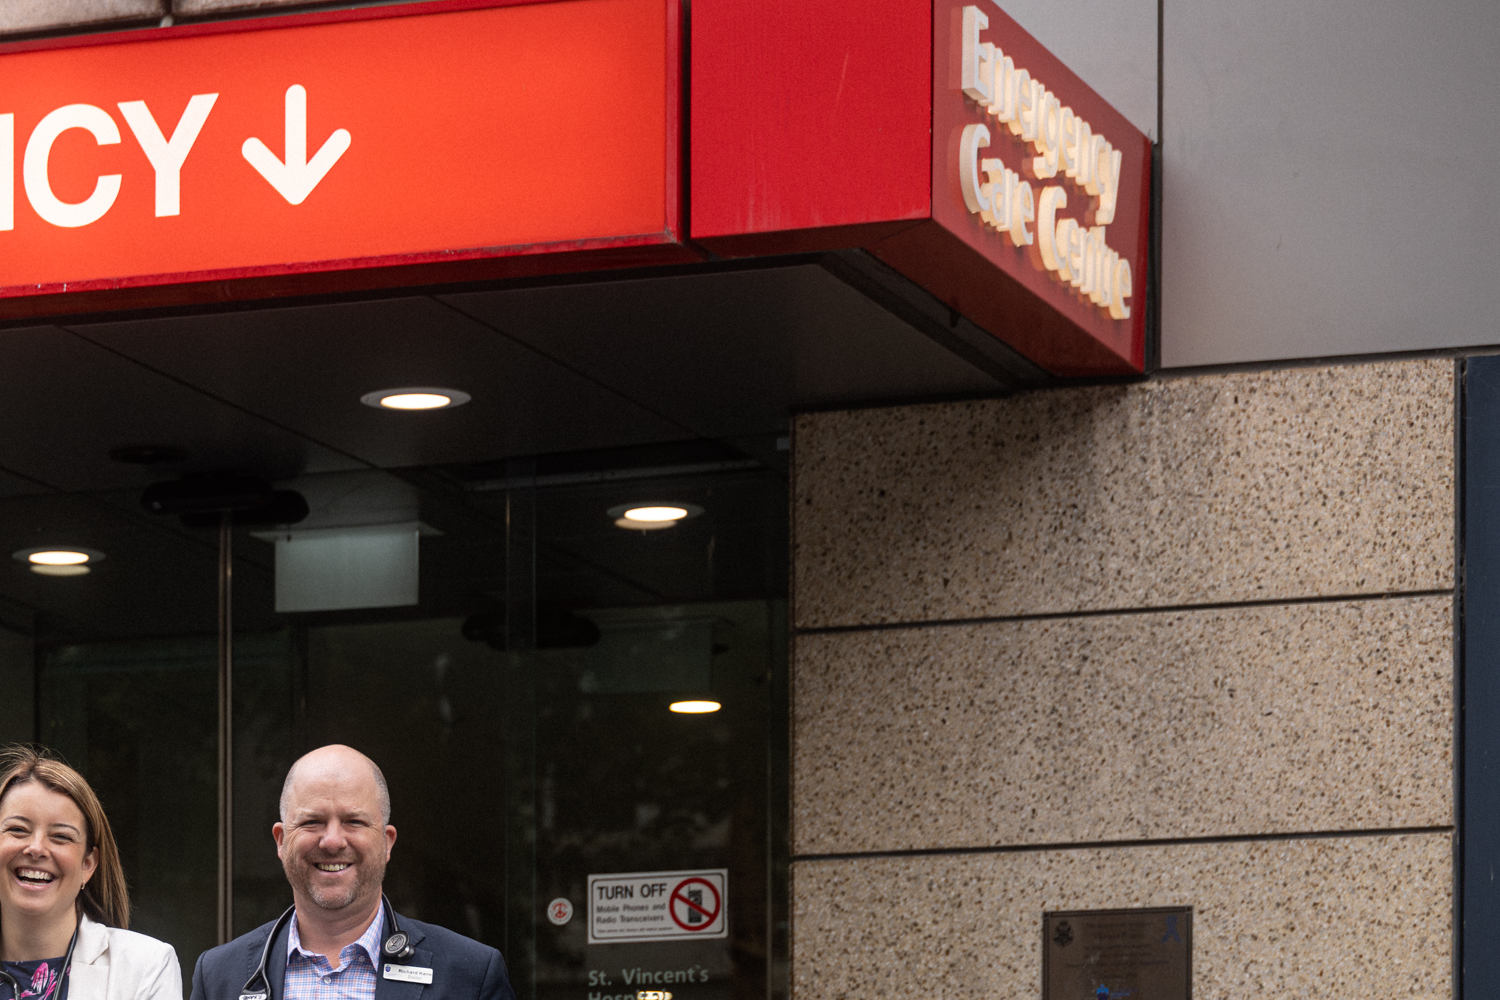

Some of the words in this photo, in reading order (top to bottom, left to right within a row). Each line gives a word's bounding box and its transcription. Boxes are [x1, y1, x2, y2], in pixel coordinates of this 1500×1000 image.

[960, 4, 1123, 225] Emergency
[959, 123, 1035, 247] Care
[597, 884, 634, 900] TURN
[640, 883, 667, 898] OFF
[596, 904, 620, 913] Mobile
[622, 903, 649, 912] Phones
[652, 902, 666, 911] and
[596, 915, 617, 924] Radio
[620, 914, 665, 924] Transceivers
[588, 969, 612, 987] St.
[622, 964, 709, 985] Vincent's
